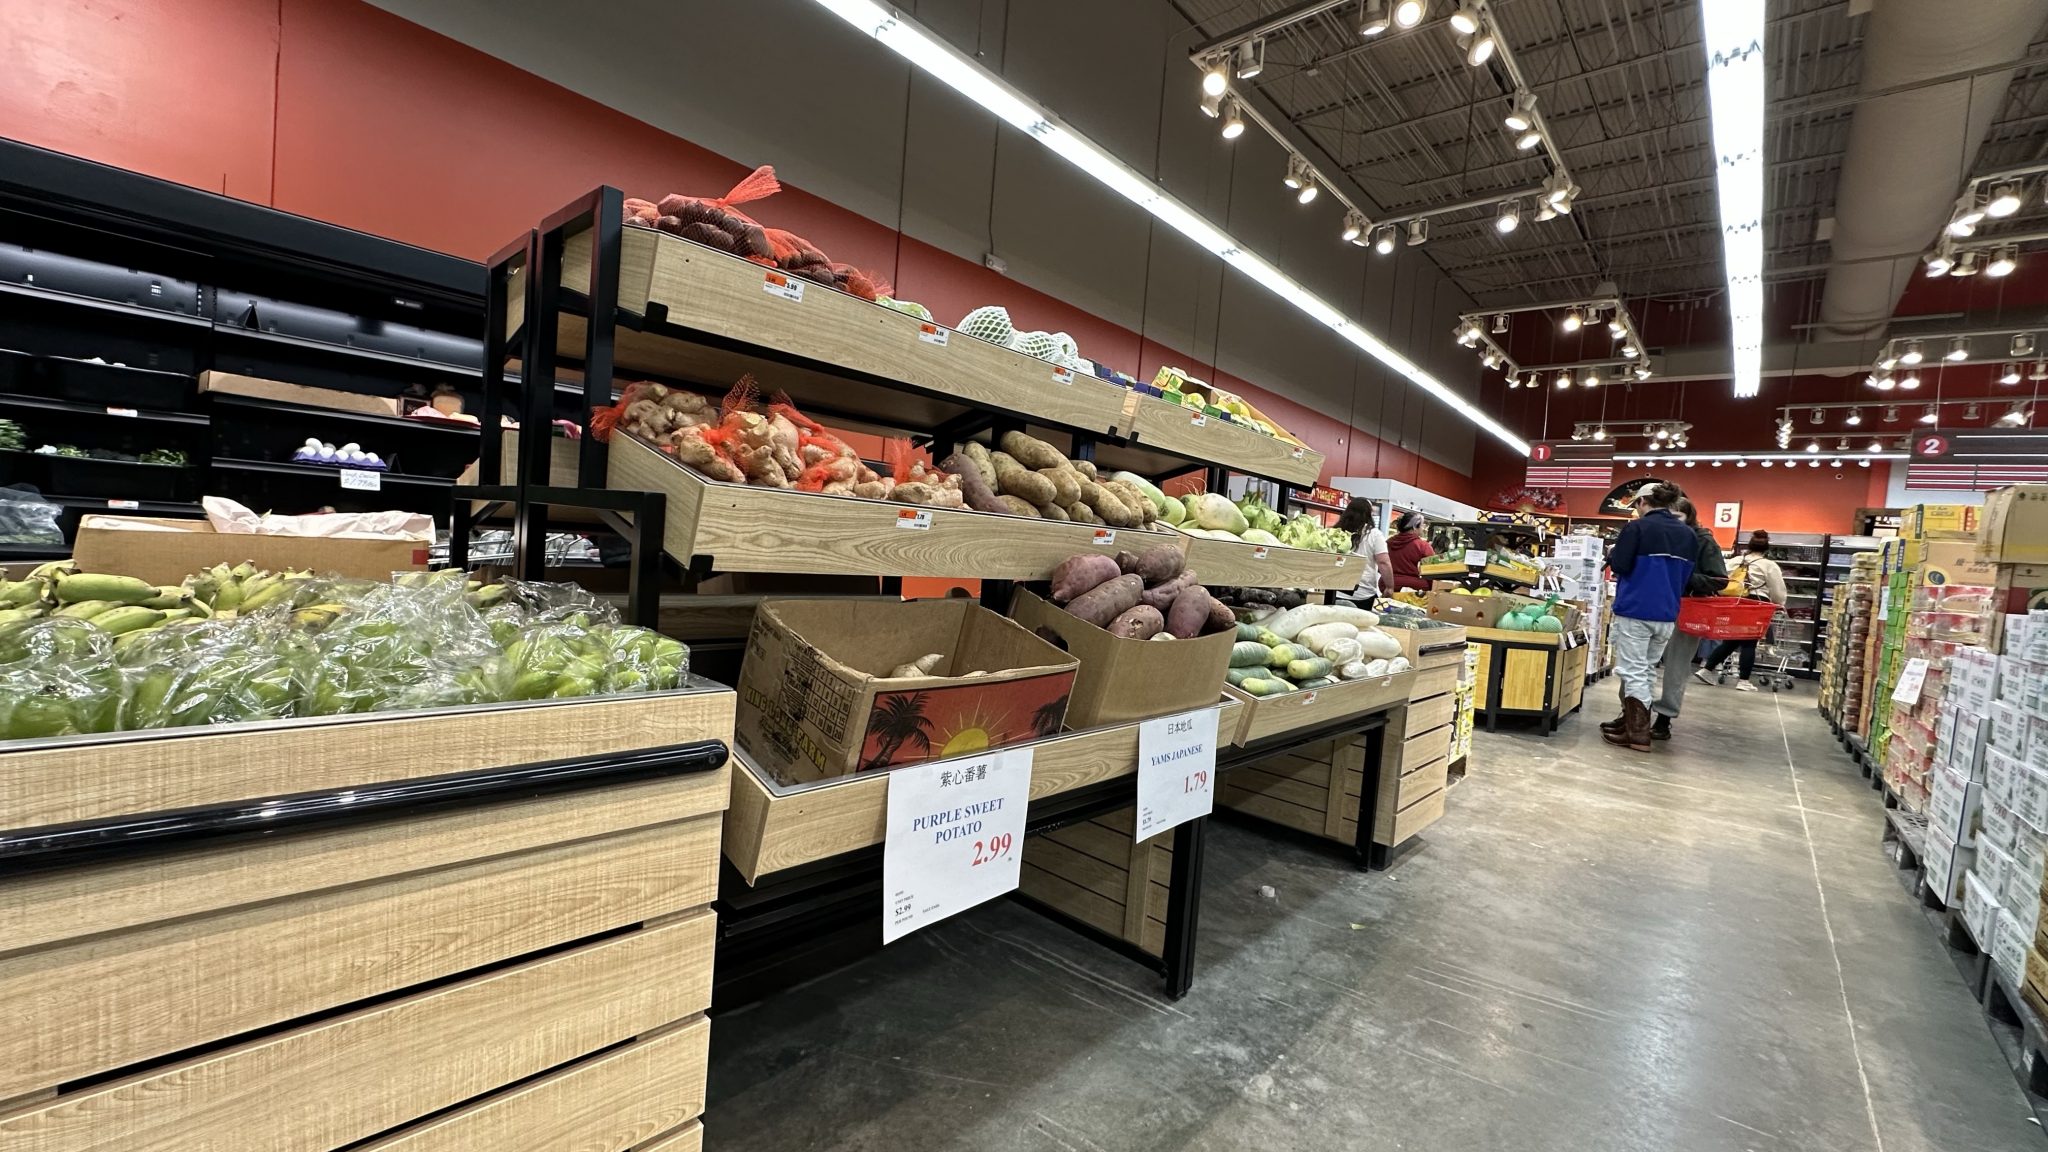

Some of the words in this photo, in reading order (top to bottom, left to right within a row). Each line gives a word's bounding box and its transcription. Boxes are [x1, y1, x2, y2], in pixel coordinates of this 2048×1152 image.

[1538, 447, 1544, 459] 1
[1923, 438, 1940, 454] 2
[1720, 507, 1733, 523] 5
[1168, 718, 1193, 735] 日本地瓜
[796, 724, 827, 773] FARM
[1151, 752, 1171, 767] YAMS
[1172, 744, 1203, 761] JAPANESE
[940, 764, 988, 788] 紫心番薯
[1184, 770, 1207, 794] 1.79
[913, 807, 962, 832] PURPLE
[964, 797, 1005, 819] SWEET
[935, 820, 982, 844] POTATO
[971, 832, 1012, 867] 2.99
